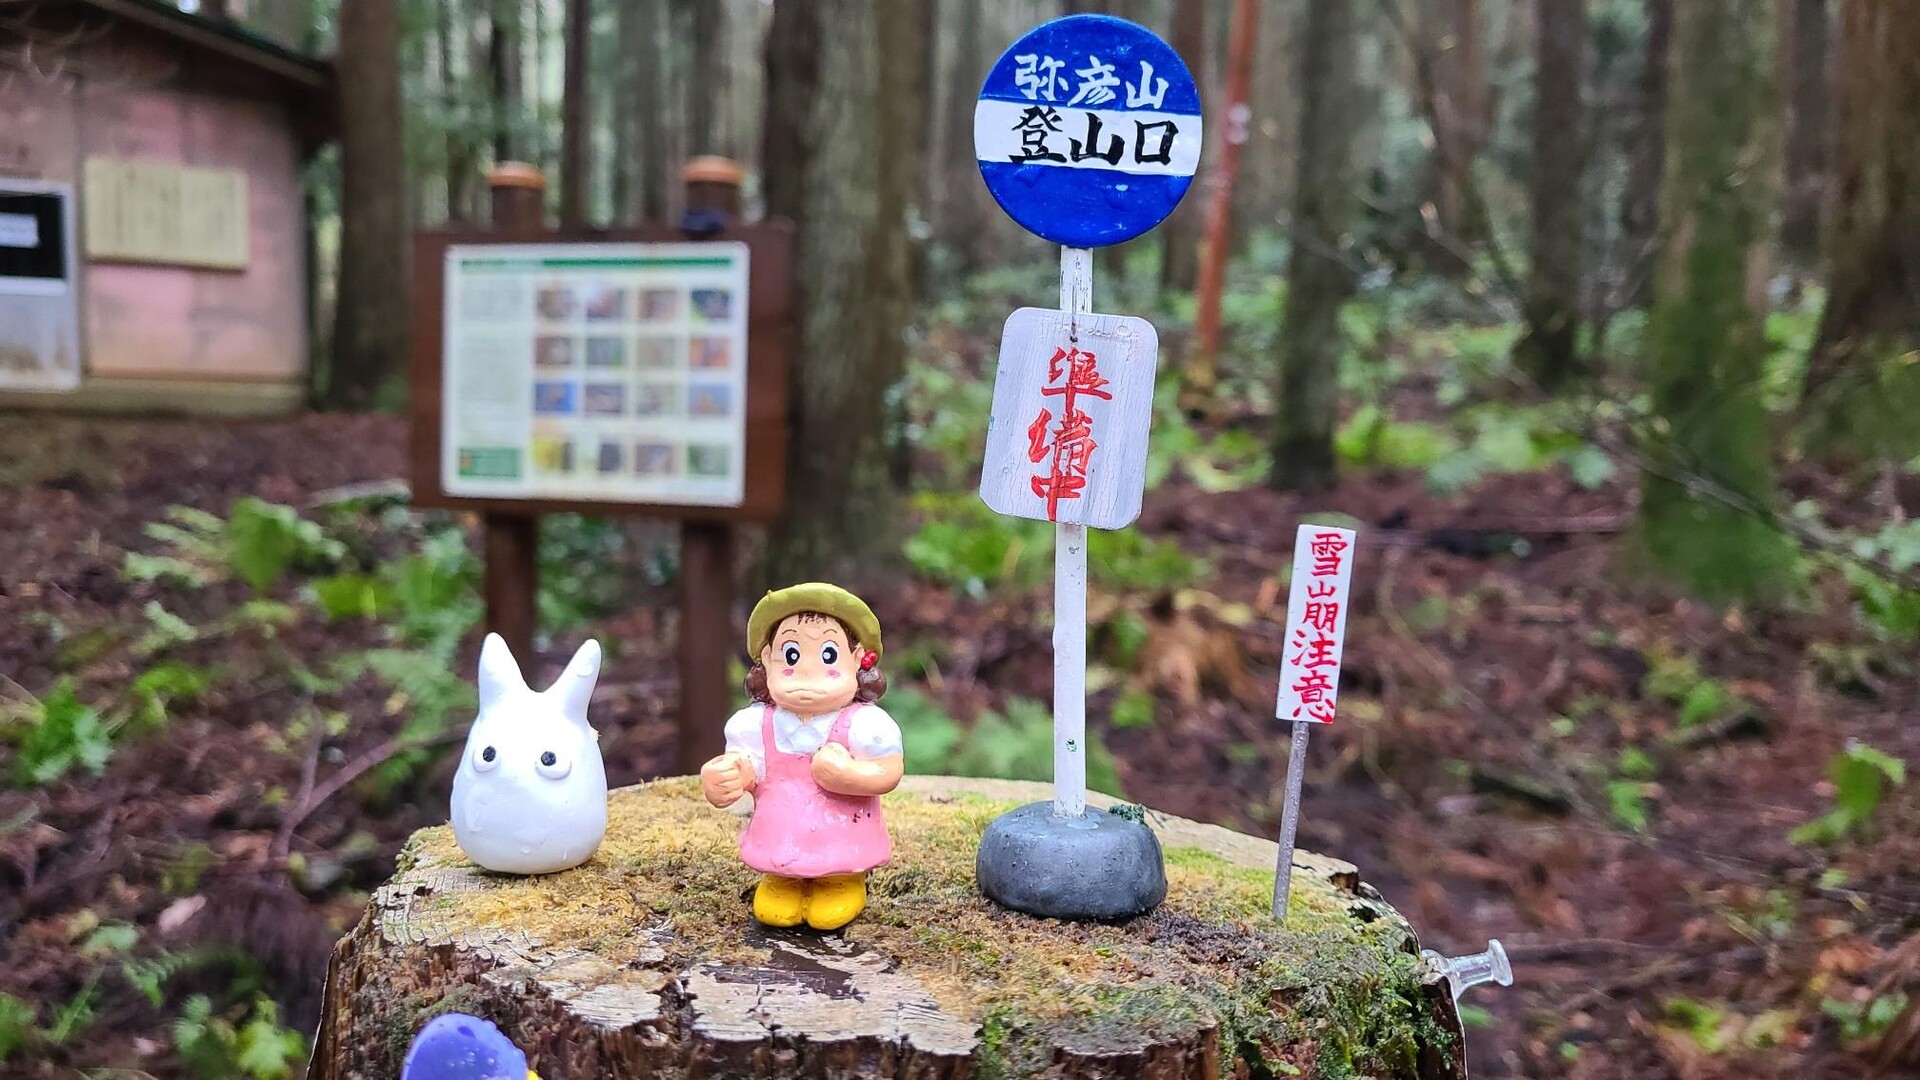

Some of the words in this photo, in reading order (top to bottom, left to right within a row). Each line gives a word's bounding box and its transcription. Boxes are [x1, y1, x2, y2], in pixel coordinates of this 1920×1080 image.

[1013, 52, 1170, 110] 弥彦山
[1008, 105, 1179, 166] 登山口
[1027, 346, 1113, 522] 準備中
